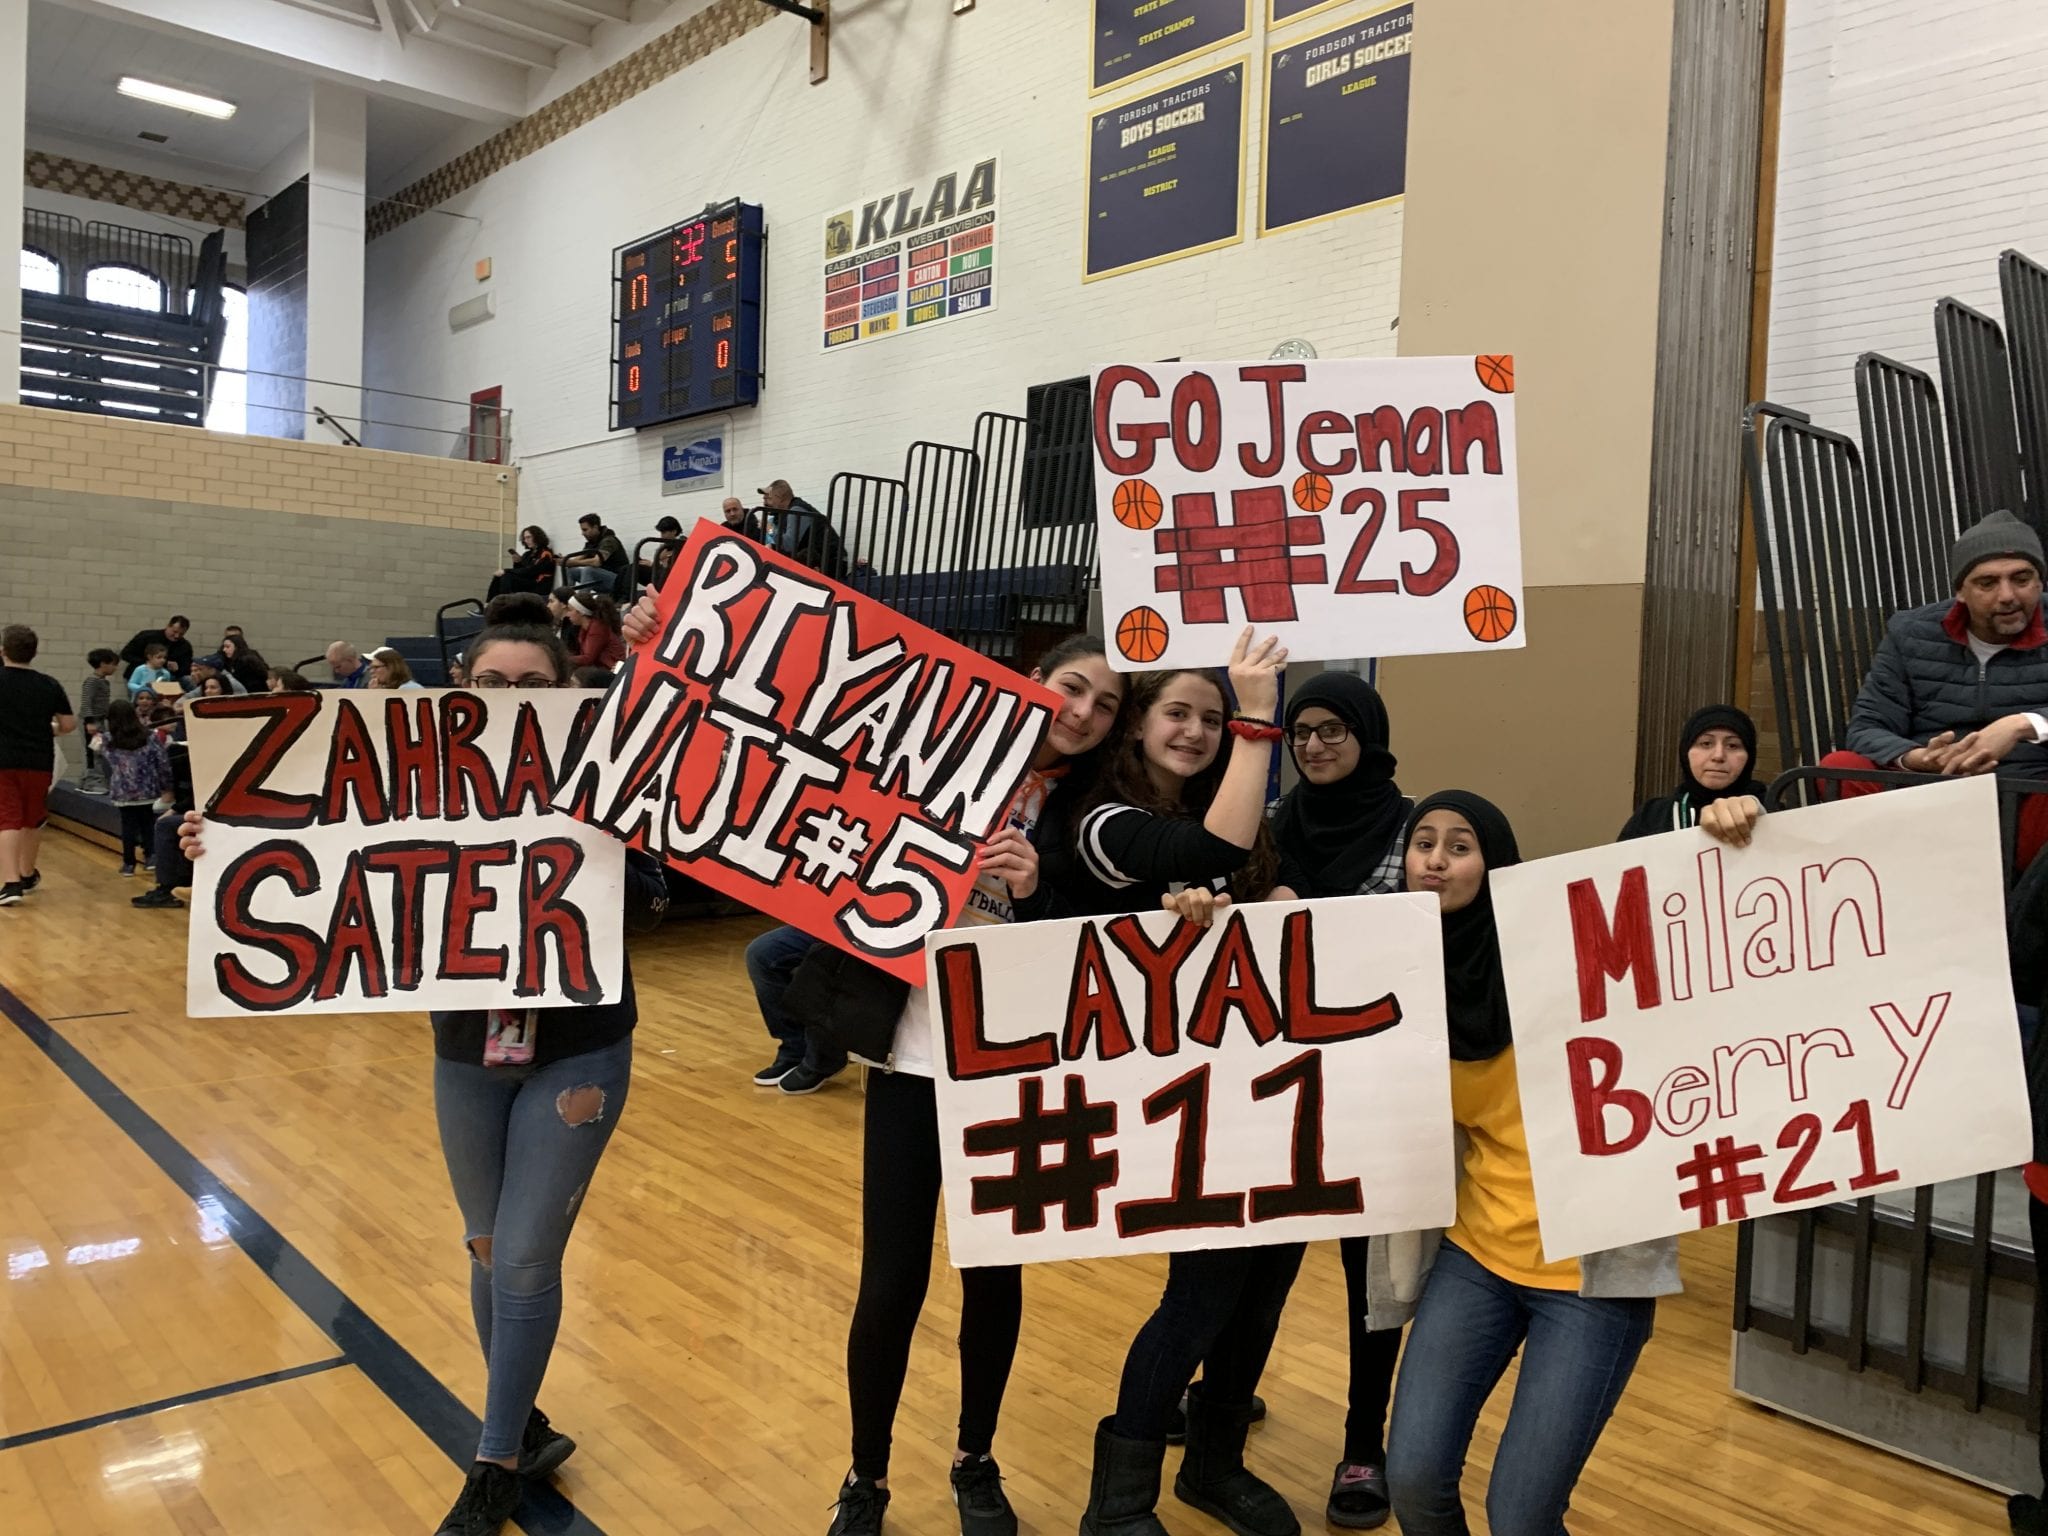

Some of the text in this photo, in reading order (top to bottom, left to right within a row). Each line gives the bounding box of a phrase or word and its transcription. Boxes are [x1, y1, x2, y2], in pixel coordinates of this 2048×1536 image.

[1138, 15, 1195, 46] STATE CHAMPS
[1305, 34, 1356, 60] FORDSON
[1305, 52, 1351, 88] GIRLS
[1342, 76, 1377, 95] LEAGUE
[1119, 83, 1211, 124] FORDSON TRACTORS
[1120, 102, 1205, 149] BOYS SOCCER
[1148, 142, 1177, 159] LEAGUE
[855, 157, 996, 250] KLAA
[1143, 179, 1178, 197] DISTRICT
[910, 213, 992, 246] WEST DIVISION
[827, 259, 851, 274] EAST
[855, 243, 898, 265] DIVISION
[914, 264, 940, 284] CANTON
[962, 252, 979, 271] NOVI
[952, 269, 988, 293] PLYMOUTH
[958, 291, 981, 312] SALEM
[869, 317, 890, 334] WAYNE
[1094, 364, 1503, 478] GO Jenan
[1154, 485, 1460, 625] #25
[655, 536, 1053, 841] RIYANN
[191, 691, 600, 829] ZAHRA
[548, 653, 975, 958] NAJI #5
[215, 837, 603, 1011] SATER
[1566, 848, 1886, 1023] Milan
[935, 908, 1402, 1080] LAYAL
[1566, 992, 1951, 1156] Berry
[963, 1049, 1364, 1238] #11
[1676, 1099, 1900, 1229] #21
